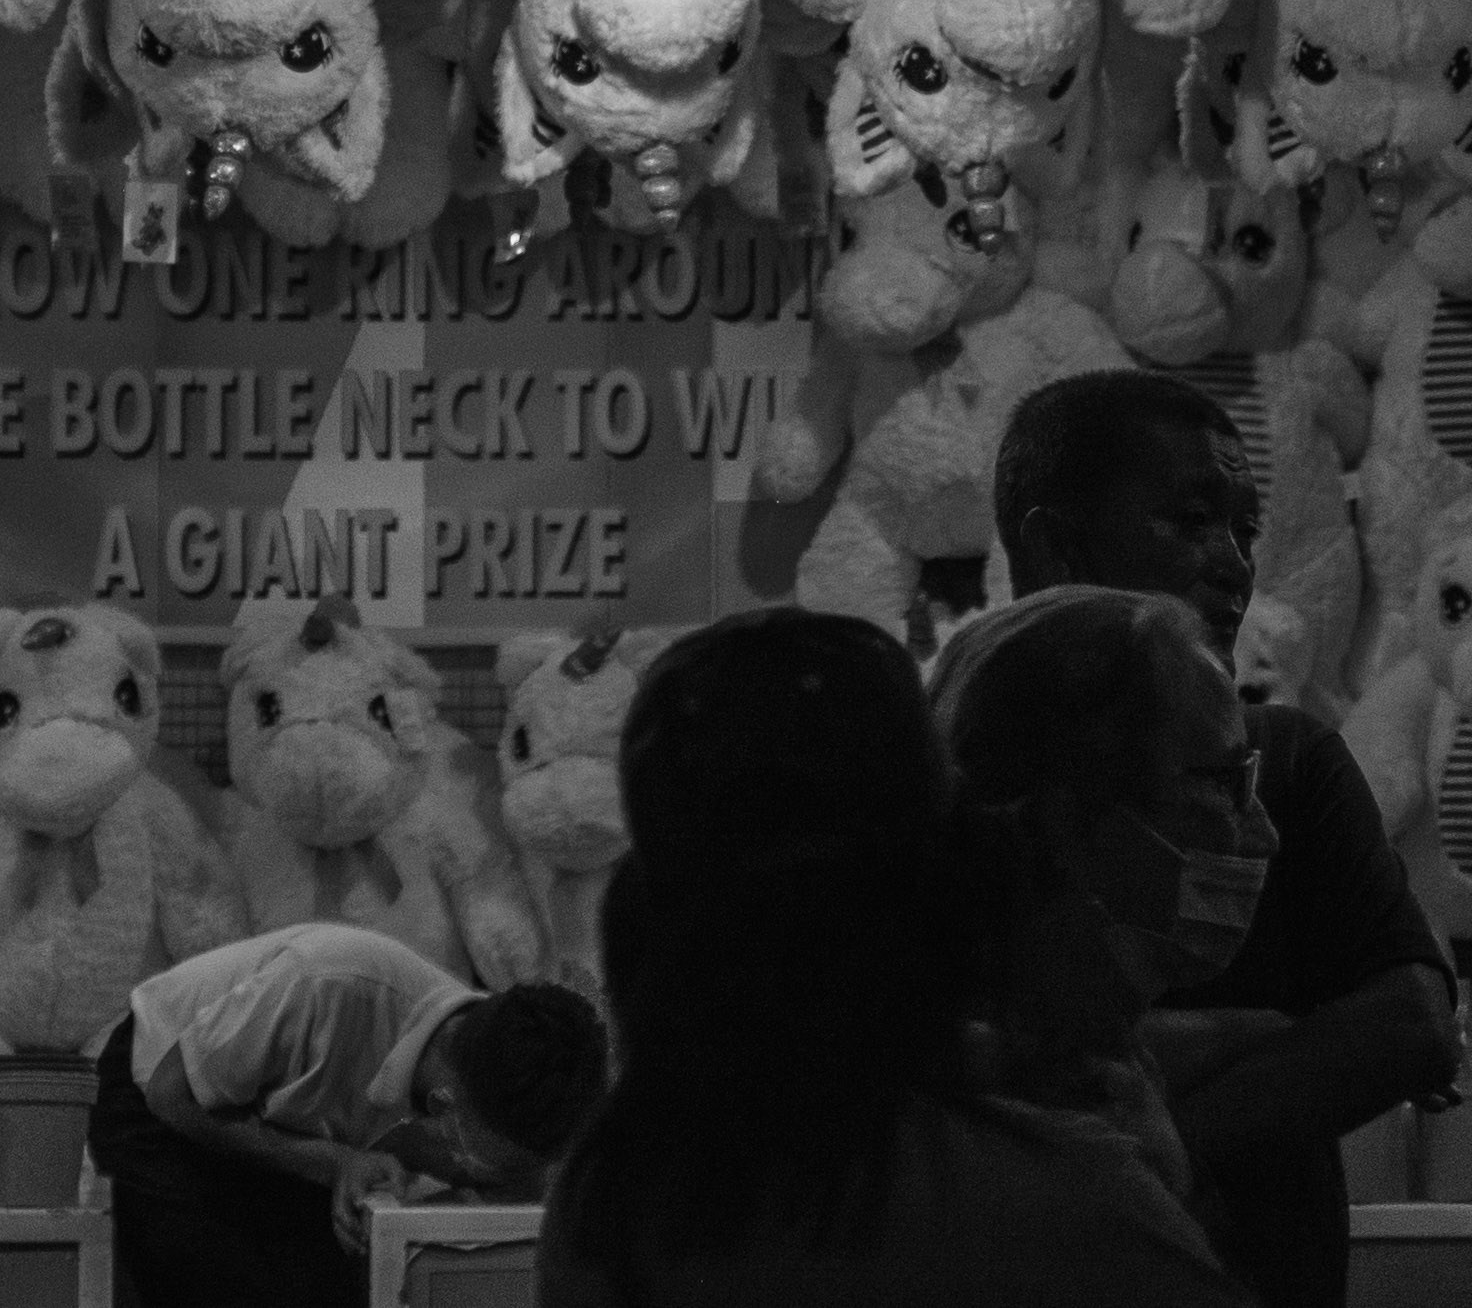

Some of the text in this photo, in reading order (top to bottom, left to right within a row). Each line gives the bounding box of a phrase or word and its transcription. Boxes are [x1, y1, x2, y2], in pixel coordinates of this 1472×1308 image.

[156, 230, 309, 321] ONE
[340, 230, 527, 321] RING
[543, 230, 818, 322] AROUN
[53, 366, 313, 460] BOTTLE
[340, 367, 535, 460] NECK
[553, 366, 653, 460] TO
[672, 367, 796, 460] WI
[94, 505, 627, 600] A GIANT PRIZE
